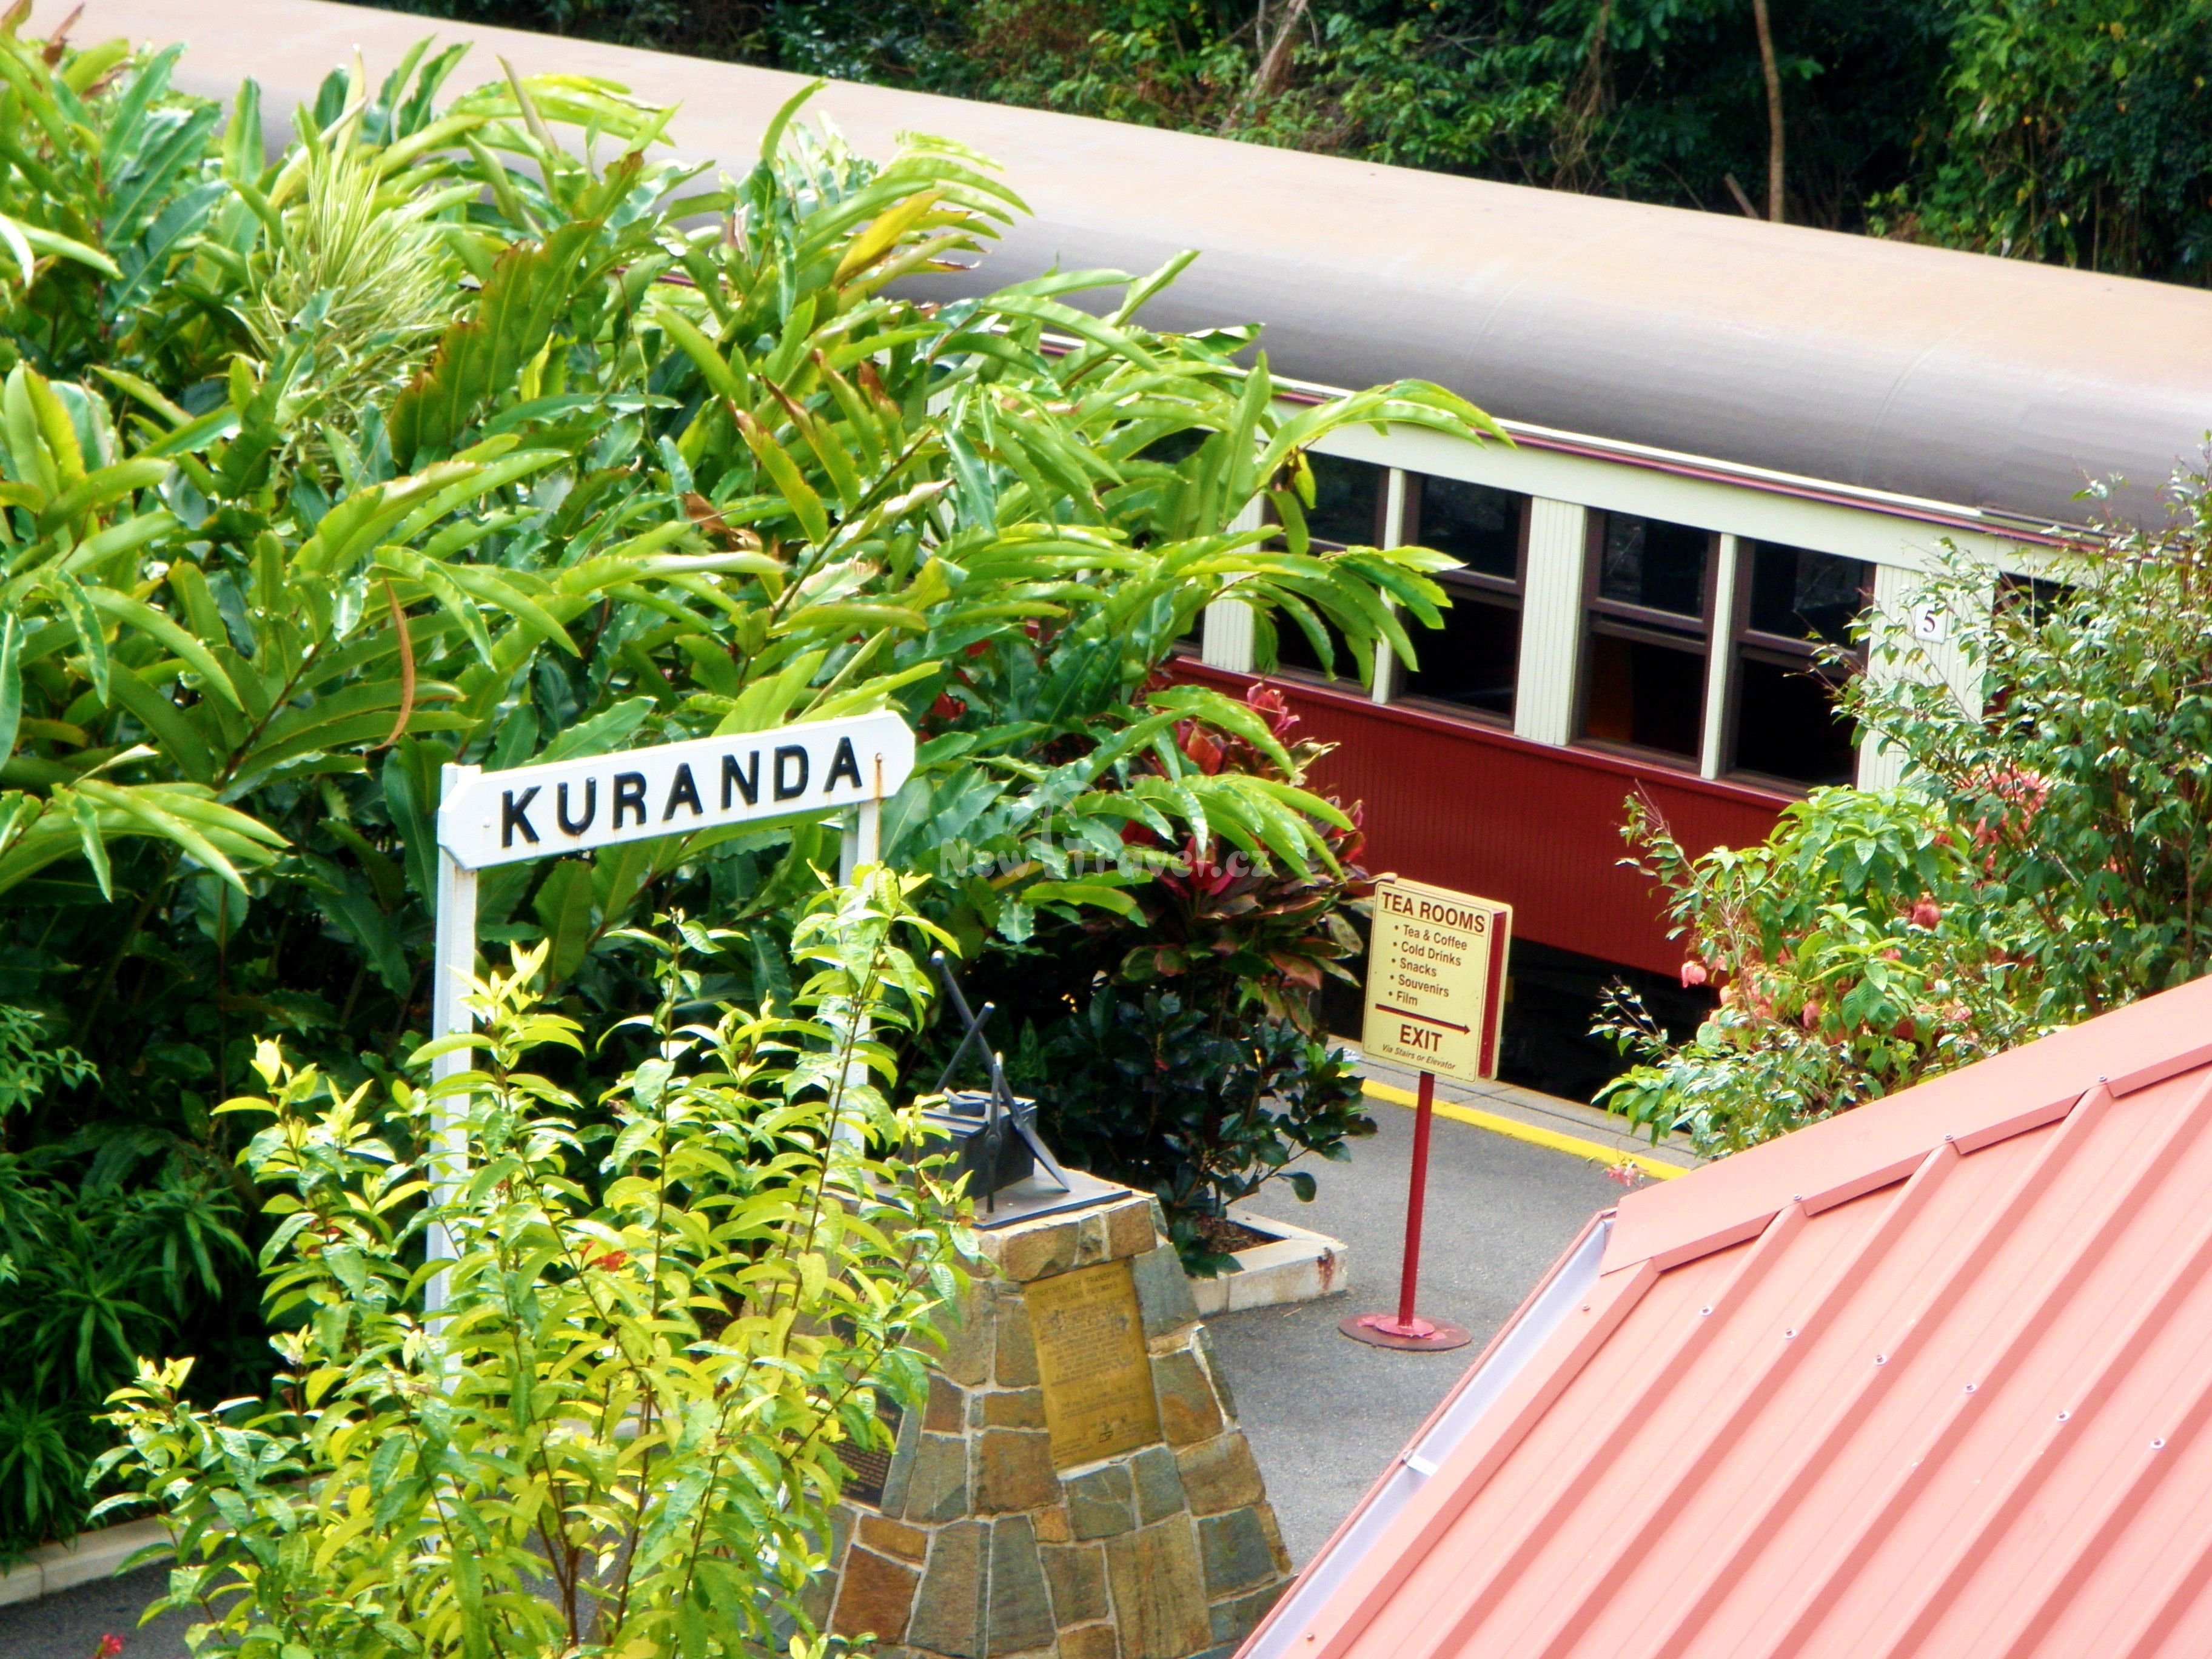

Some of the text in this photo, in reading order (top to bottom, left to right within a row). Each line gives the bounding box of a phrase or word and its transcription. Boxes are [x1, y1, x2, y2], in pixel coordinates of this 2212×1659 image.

[1923, 610, 1936, 633] 5
[501, 736, 863, 848] KURANDA
[1382, 892, 1485, 933] TEA ROOMS
[1403, 924, 1467, 950] Tea & Coffee
[1399, 957, 1437, 977] Snacks
[1401, 941, 1461, 967] Cold Drinks
[1396, 990, 1418, 1006] Film
[1398, 974, 1450, 997] Souvenirs
[1399, 1024, 1443, 1052] EXIT
[1382, 1044, 1393, 1053] Via
[1394, 1047, 1415, 1059] Stairs
[1426, 1055, 1456, 1070] Elevator
